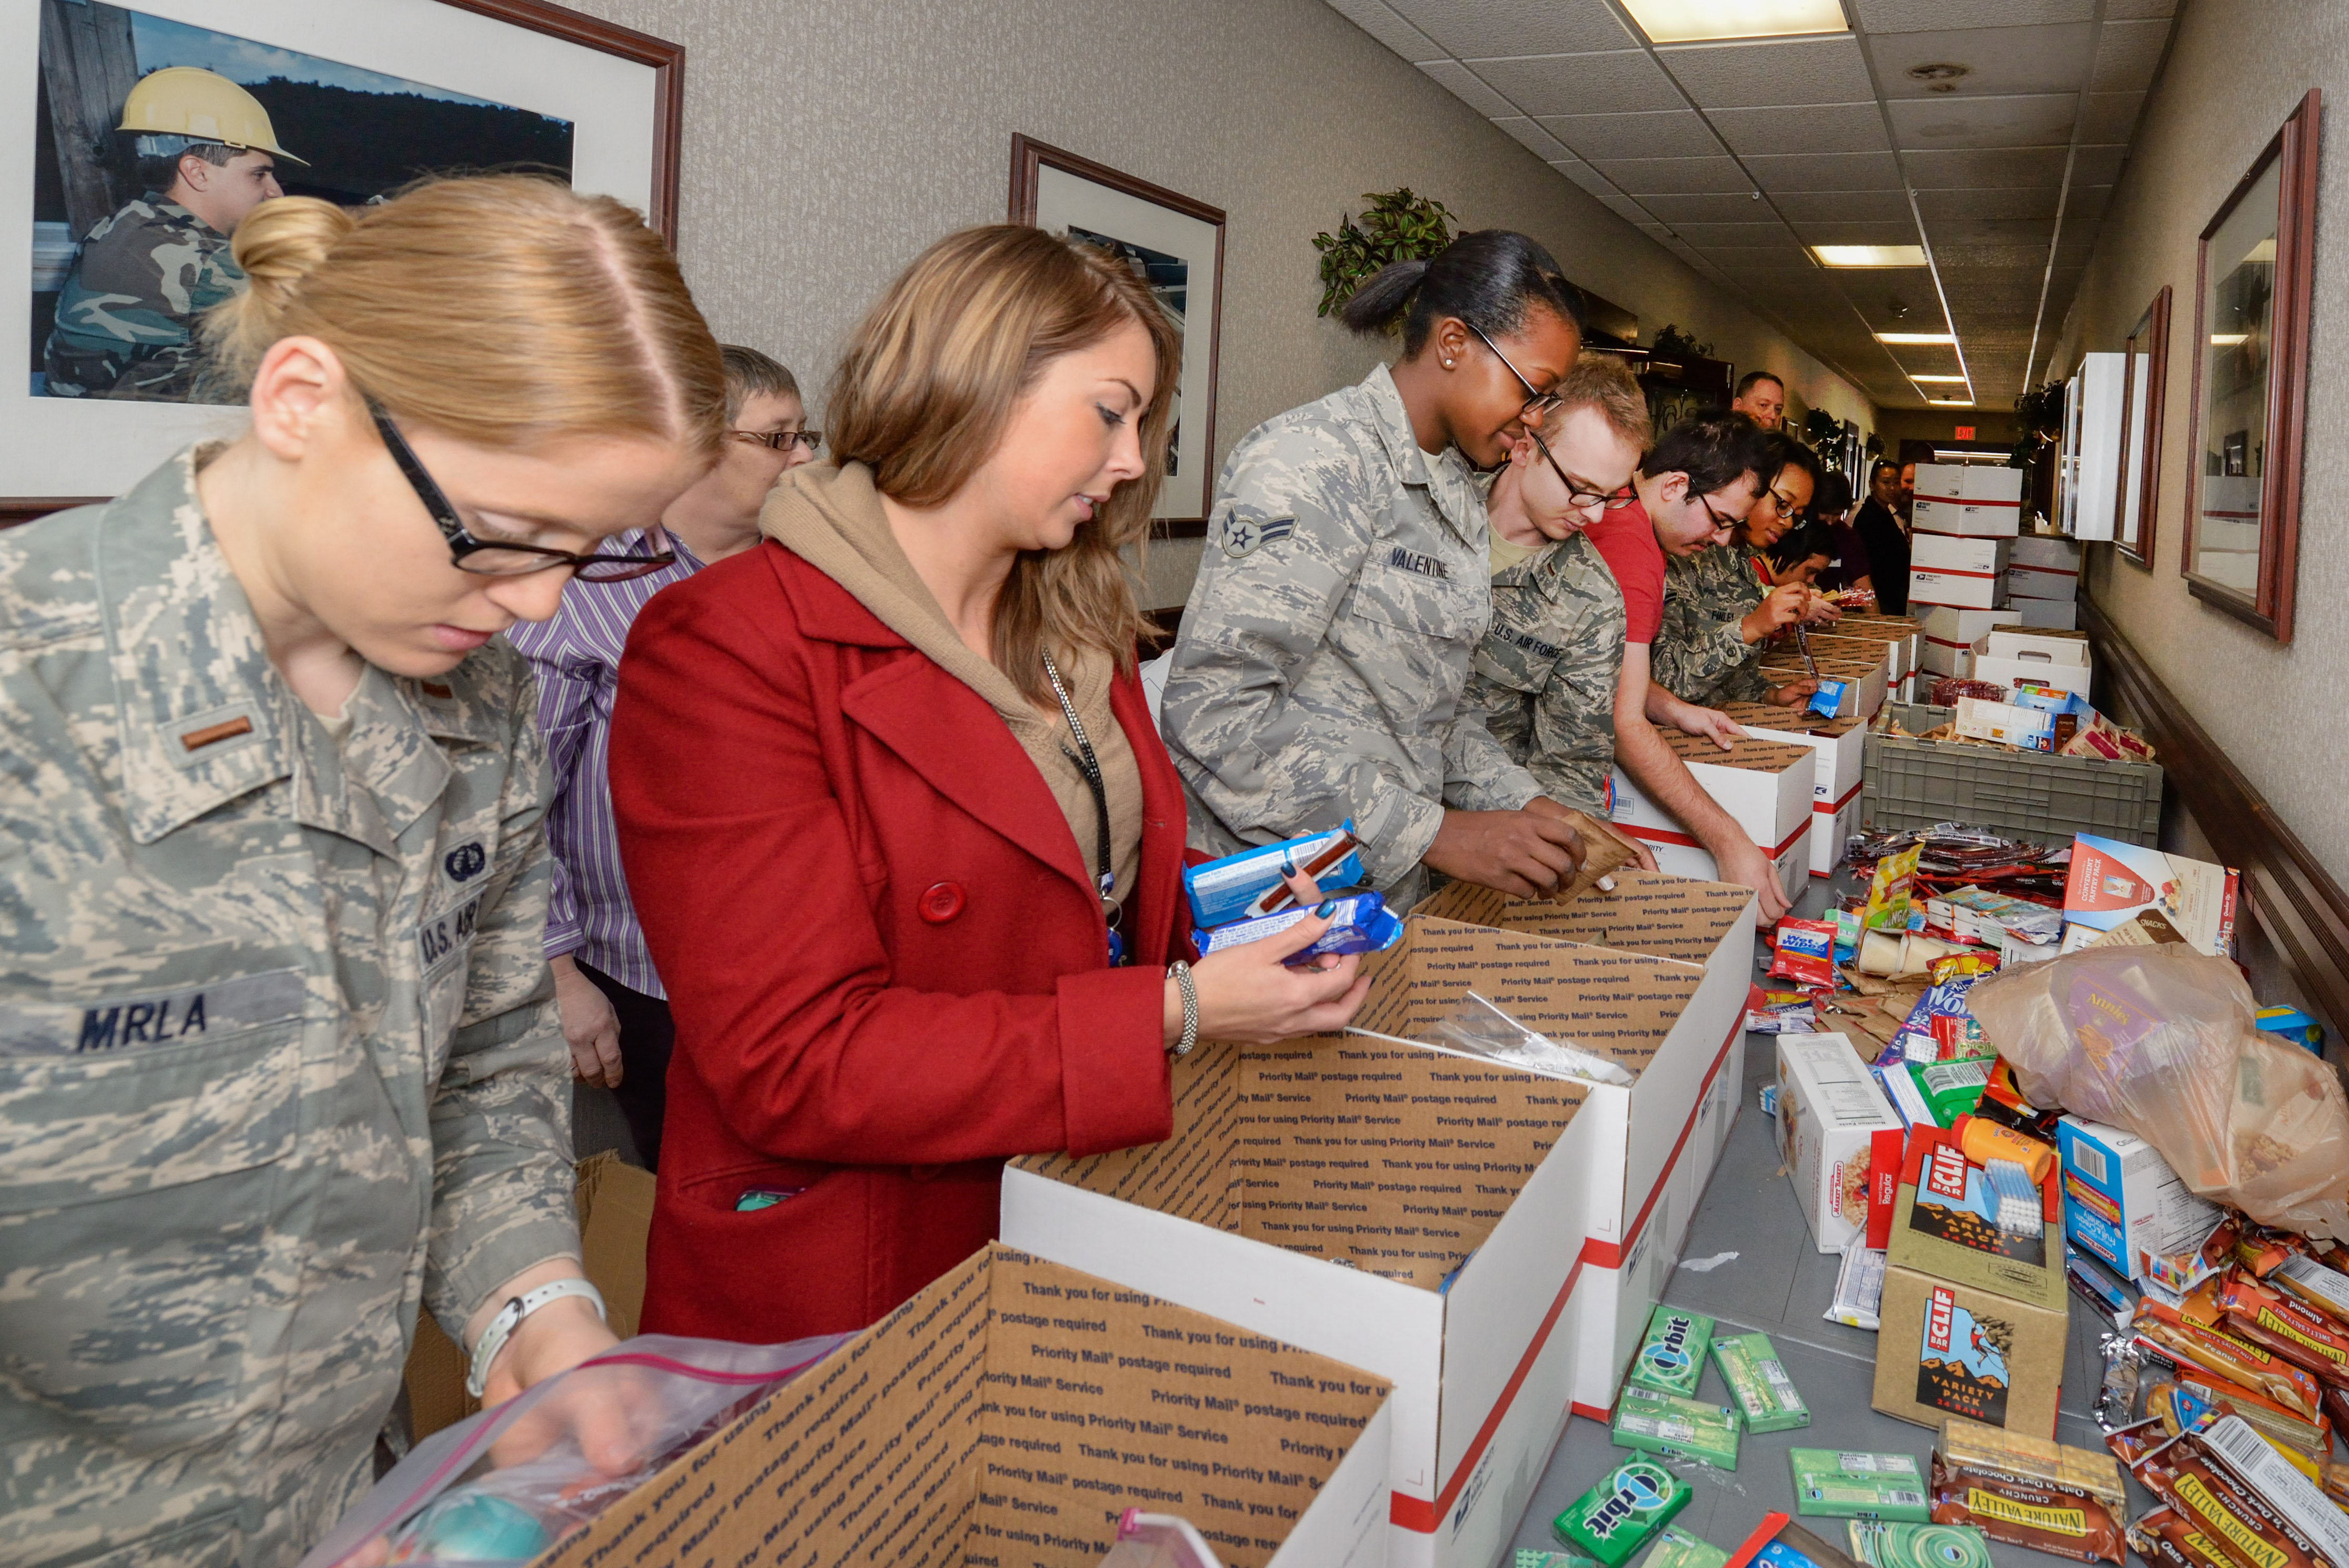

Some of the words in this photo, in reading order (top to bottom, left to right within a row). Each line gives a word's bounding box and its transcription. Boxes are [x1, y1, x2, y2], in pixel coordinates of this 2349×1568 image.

[1957, 427, 1973, 439] EXIT
[1392, 548, 1449, 579] VALENTINE
[1712, 611, 1734, 622] FINLEY
[1494, 623, 1512, 642] U.S.
[1515, 635, 1533, 650] AIR
[1532, 642, 1564, 660] FORCE
[2081, 857, 2093, 901] CONVENIENT
[2089, 877, 2099, 903] PANTRY
[1577, 895, 1603, 904] Priority
[2140, 919, 2166, 929] SNACKS
[422, 922, 452, 964] U.S.
[1782, 939, 1825, 952] Wipes
[1480, 961, 1512, 969] postage
[1515, 959, 1550, 968] required
[1593, 975, 1629, 984] required
[77, 993, 208, 1052] MRLA
[1908, 1015, 1929, 1025] 22
[1344, 1092, 1380, 1104] Priority
[1411, 1095, 1451, 1104] postage
[1453, 1095, 1496, 1105] required
[1933, 1145, 1965, 1187] CLIF
[1882, 1174, 1893, 1205] Regular
[1932, 1182, 1961, 1197] BAR
[1261, 1221, 1290, 1230] Thank
[1292, 1224, 1309, 1232] you
[1311, 1223, 1325, 1231] for
[1328, 1224, 1354, 1235] using
[1355, 1225, 1391, 1236] Priority
[1422, 1227, 1460, 1238] Service
[1931, 1212, 2024, 1243] VARIETY
[2074, 1212, 2097, 1232] Cream
[2084, 1210, 2106, 1232] Variety
[1949, 1226, 2004, 1247] PACK
[2102, 1231, 2115, 1246] Fruit
[1968, 1240, 2010, 1256] BARS
[1932, 1290, 1952, 1338] CLIF
[2275, 1308, 2288, 1319] NUT
[2289, 1300, 2323, 1324] Almond
[2288, 1316, 2305, 1331] SALTY
[1142, 1324, 1183, 1340] Thank
[1187, 1332, 1211, 1344] you
[1214, 1332, 1234, 1346] for
[1239, 1336, 1278, 1353] using
[1930, 1336, 1948, 1347] BAR
[2195, 1329, 2216, 1340] SWEET
[2221, 1340, 2239, 1352] SALTY
[2240, 1351, 2254, 1361] NUT
[2311, 1331, 2331, 1343] SWEET
[2204, 1342, 2238, 1363] Peanut
[763, 1394, 814, 1441] Thank
[819, 1363, 846, 1394] you
[850, 1339, 871, 1362] for
[876, 1299, 914, 1339] using
[1932, 1374, 1994, 1400] VARIETY
[1943, 1389, 1980, 1407] PACK
[1151, 1389, 1200, 1409] Priority
[1244, 1404, 1300, 1421] postage
[1305, 1411, 1367, 1429] required
[1937, 1398, 1950, 1407] 24
[1955, 1404, 1984, 1418] BARS
[776, 1437, 835, 1498] Priority
[882, 1344, 934, 1398] postage
[1962, 1466, 2014, 1483] Chocolate
[2018, 1476, 2043, 1489] Dark
[2200, 1456, 2246, 1497] Chocolate
[1999, 1489, 2049, 1504] CRUNCHY
[2058, 1485, 2084, 1498] Oats
[2178, 1477, 2224, 1525] VALLEY
[1201, 1493, 1243, 1511] Thank
[1248, 1503, 1273, 1516] you
[1277, 1504, 1298, 1520] for
[1972, 1491, 2023, 1521] VALLEY
[2216, 1491, 2263, 1531] CRUNCHY
[2247, 1497, 2272, 1520] Dark
[2024, 1509, 2082, 1534] NATURE
[2222, 1518, 2283, 1568] NATURE
[2284, 1526, 2310, 1552] Oats
[2161, 1541, 2184, 1564] Oats
